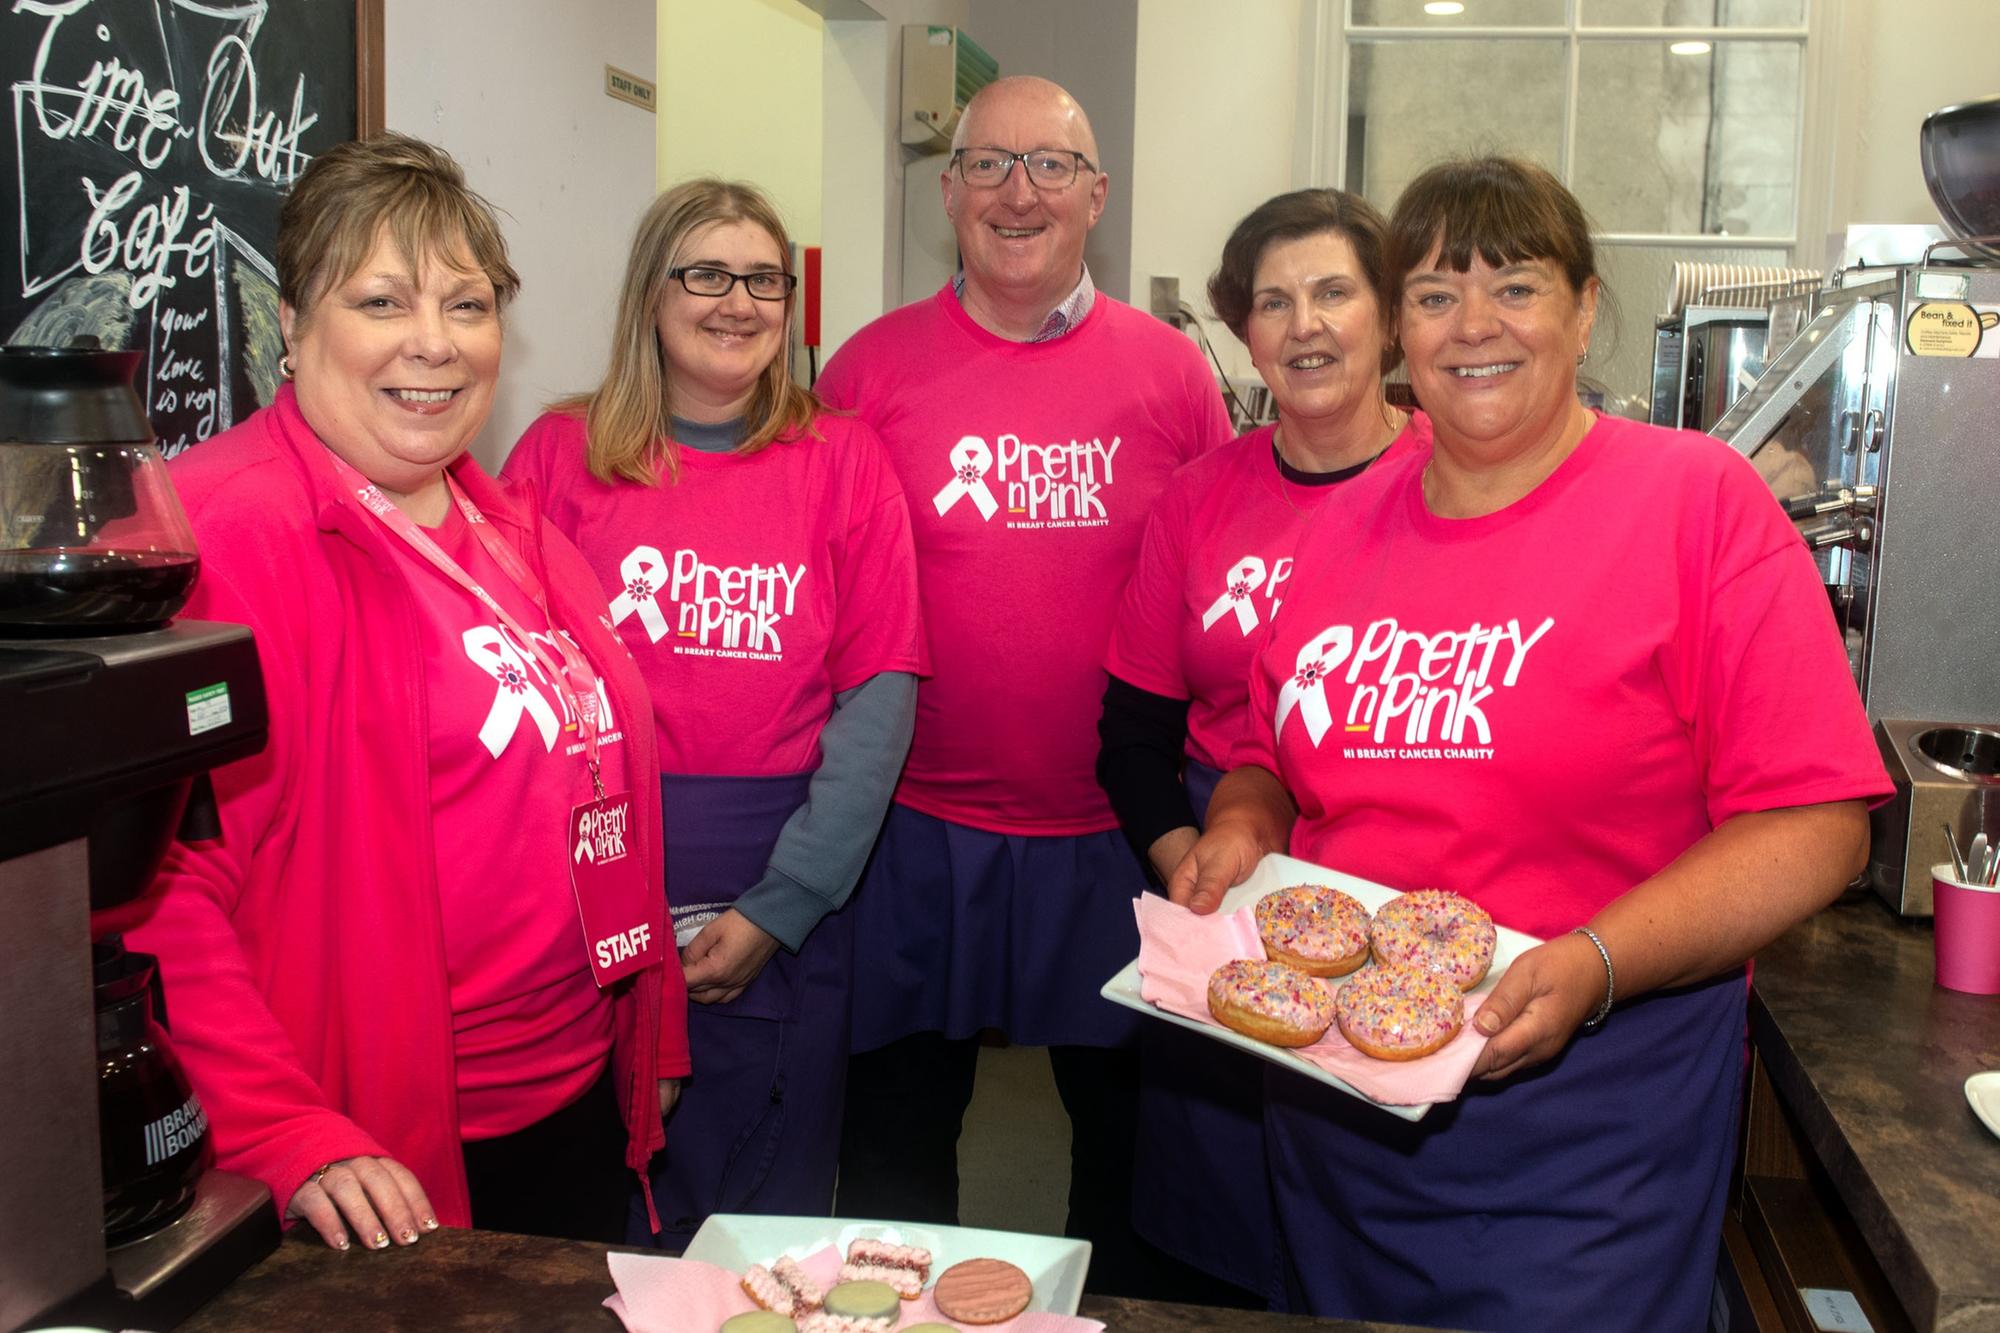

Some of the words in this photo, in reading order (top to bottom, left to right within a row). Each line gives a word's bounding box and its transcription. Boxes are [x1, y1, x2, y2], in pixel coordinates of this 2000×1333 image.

[12, 0, 181, 169] Time
[198, 35, 318, 186] Out
[612, 75, 632, 93] STAFF
[633, 84, 651, 100] ONLY
[1920, 310, 1944, 320] Bean
[1942, 319, 1964, 328] fixed
[1017, 521, 1045, 529] BREAST
[1046, 520, 1076, 529] CANCER
[1077, 519, 1110, 528] CHARITY
[684, 647, 715, 657] BREAST
[716, 650, 748, 659] CANCER
[748, 652, 783, 661] CHARITY
[597, 731, 623, 746] ANCER
[1356, 748, 1396, 759] BREAST
[1398, 748, 1442, 759] CANCER
[1443, 748, 1494, 760] CHARITY
[595, 922, 651, 969] STAFF
